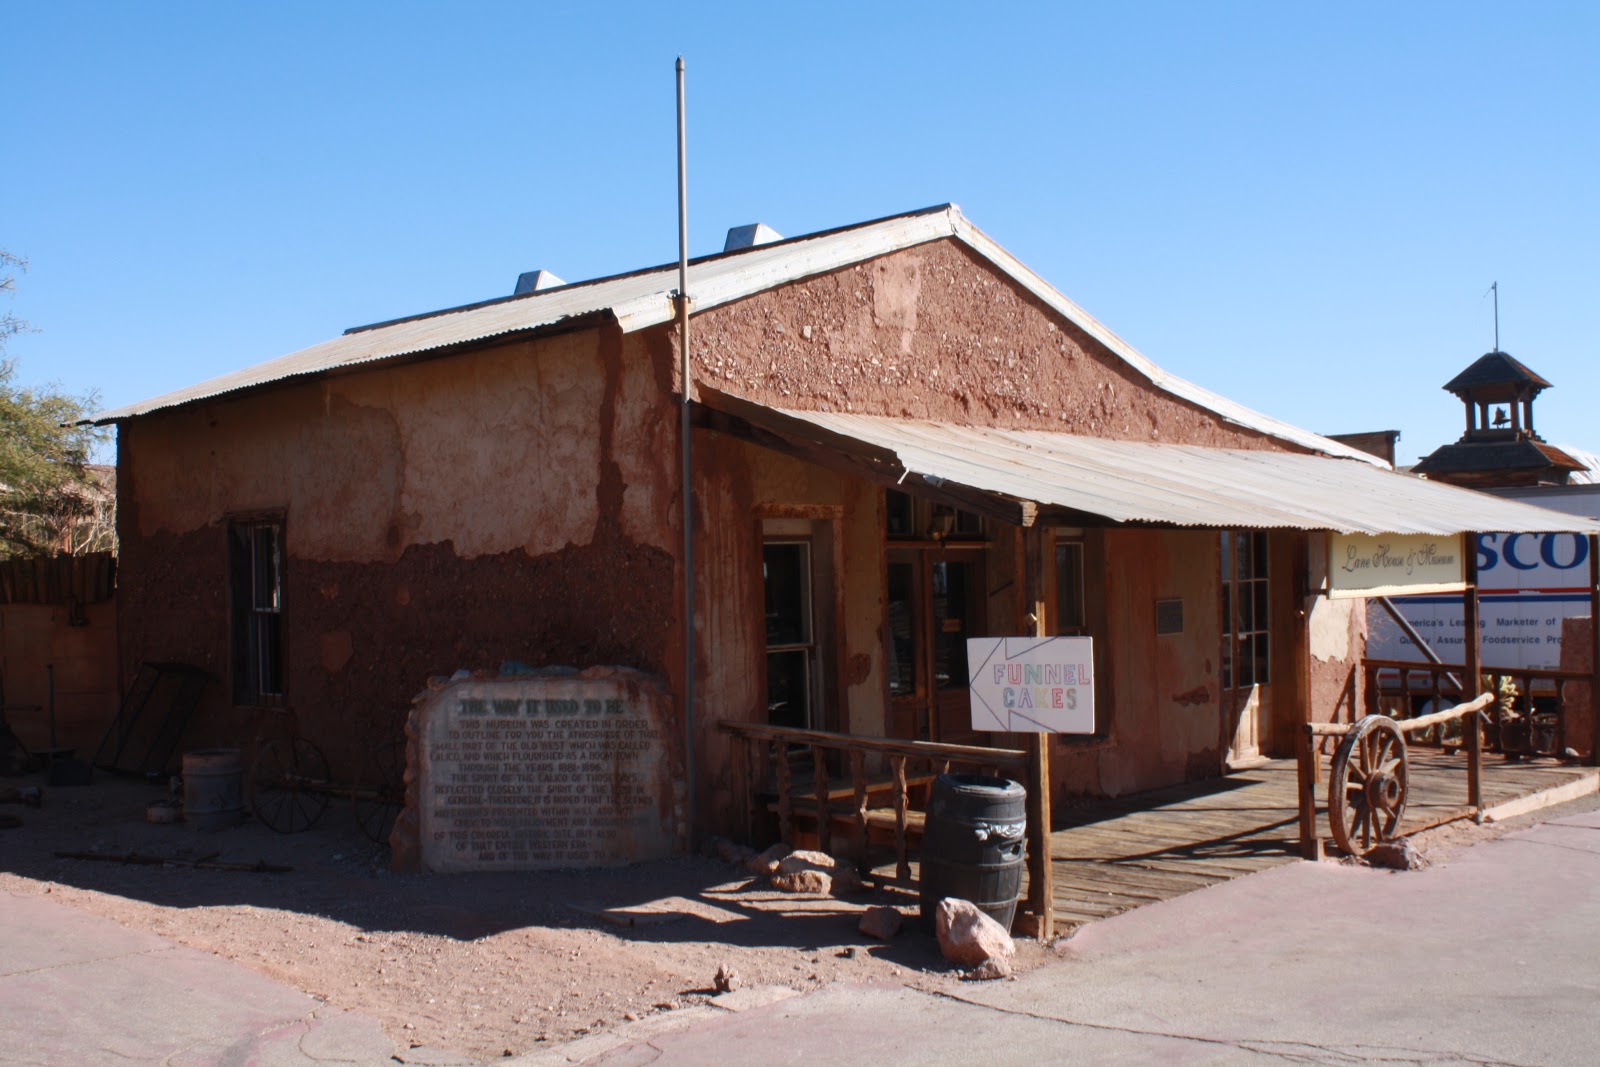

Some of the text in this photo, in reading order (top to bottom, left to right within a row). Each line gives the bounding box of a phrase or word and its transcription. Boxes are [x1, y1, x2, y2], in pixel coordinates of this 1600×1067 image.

[1342, 544, 1370, 572] Lane
[1373, 544, 1404, 568] House
[1417, 544, 1454, 566] Museum
[1407, 618, 1444, 627] merica's
[1496, 617, 1539, 627] Marketer
[1545, 617, 1556, 626] of
[1437, 636, 1466, 645] Assur
[1482, 635, 1540, 645] Foodservice
[993, 663, 1091, 686] FUNNEL
[1003, 687, 1077, 710] CAKES
[460, 699, 486, 713] THE
[492, 699, 521, 713] WAY
[526, 699, 540, 713] IT
[606, 699, 624, 713] BE
[460, 720, 480, 729] THIS
[486, 720, 526, 729] MUSEUM
[530, 720, 550, 729] WAS
[555, 720, 598, 729] CREATED
[602, 720, 611, 729] IN
[449, 730, 659, 739] TO OUTLINE FOR YOU THE ATMOSPHERE OF THAT
[462, 742, 482, 750] PART
[486, 742, 495, 750] OF
[502, 742, 516, 750] THE
[520, 742, 538, 750] OLD
[569, 742, 596, 750] WHICH
[620, 742, 650, 750] CALLED
[464, 752, 480, 761] AND
[484, 752, 509, 761] WHICH
[512, 752, 563, 761] FLOURISHED
[566, 752, 577, 761] AS
[580, 752, 586, 761] A
[459, 763, 499, 772] THROUGH
[504, 763, 520, 772] THE
[525, 763, 553, 772] YEARS
[452, 773, 467, 782] THE
[472, 773, 497, 782] SPIRIT
[501, 773, 512, 782] OF
[517, 773, 533, 782] THE
[538, 773, 567, 782] CALICO
[572, 773, 581, 782] OF
[434, 785, 484, 794] REFLECTED
[487, 785, 523, 794] CLOSELY
[528, 785, 544, 794] THE
[547, 785, 572, 794] SPIRIT
[576, 785, 586, 794] OF
[554, 796, 579, 805] HOPED
[541, 808, 569, 816] WITHIN
